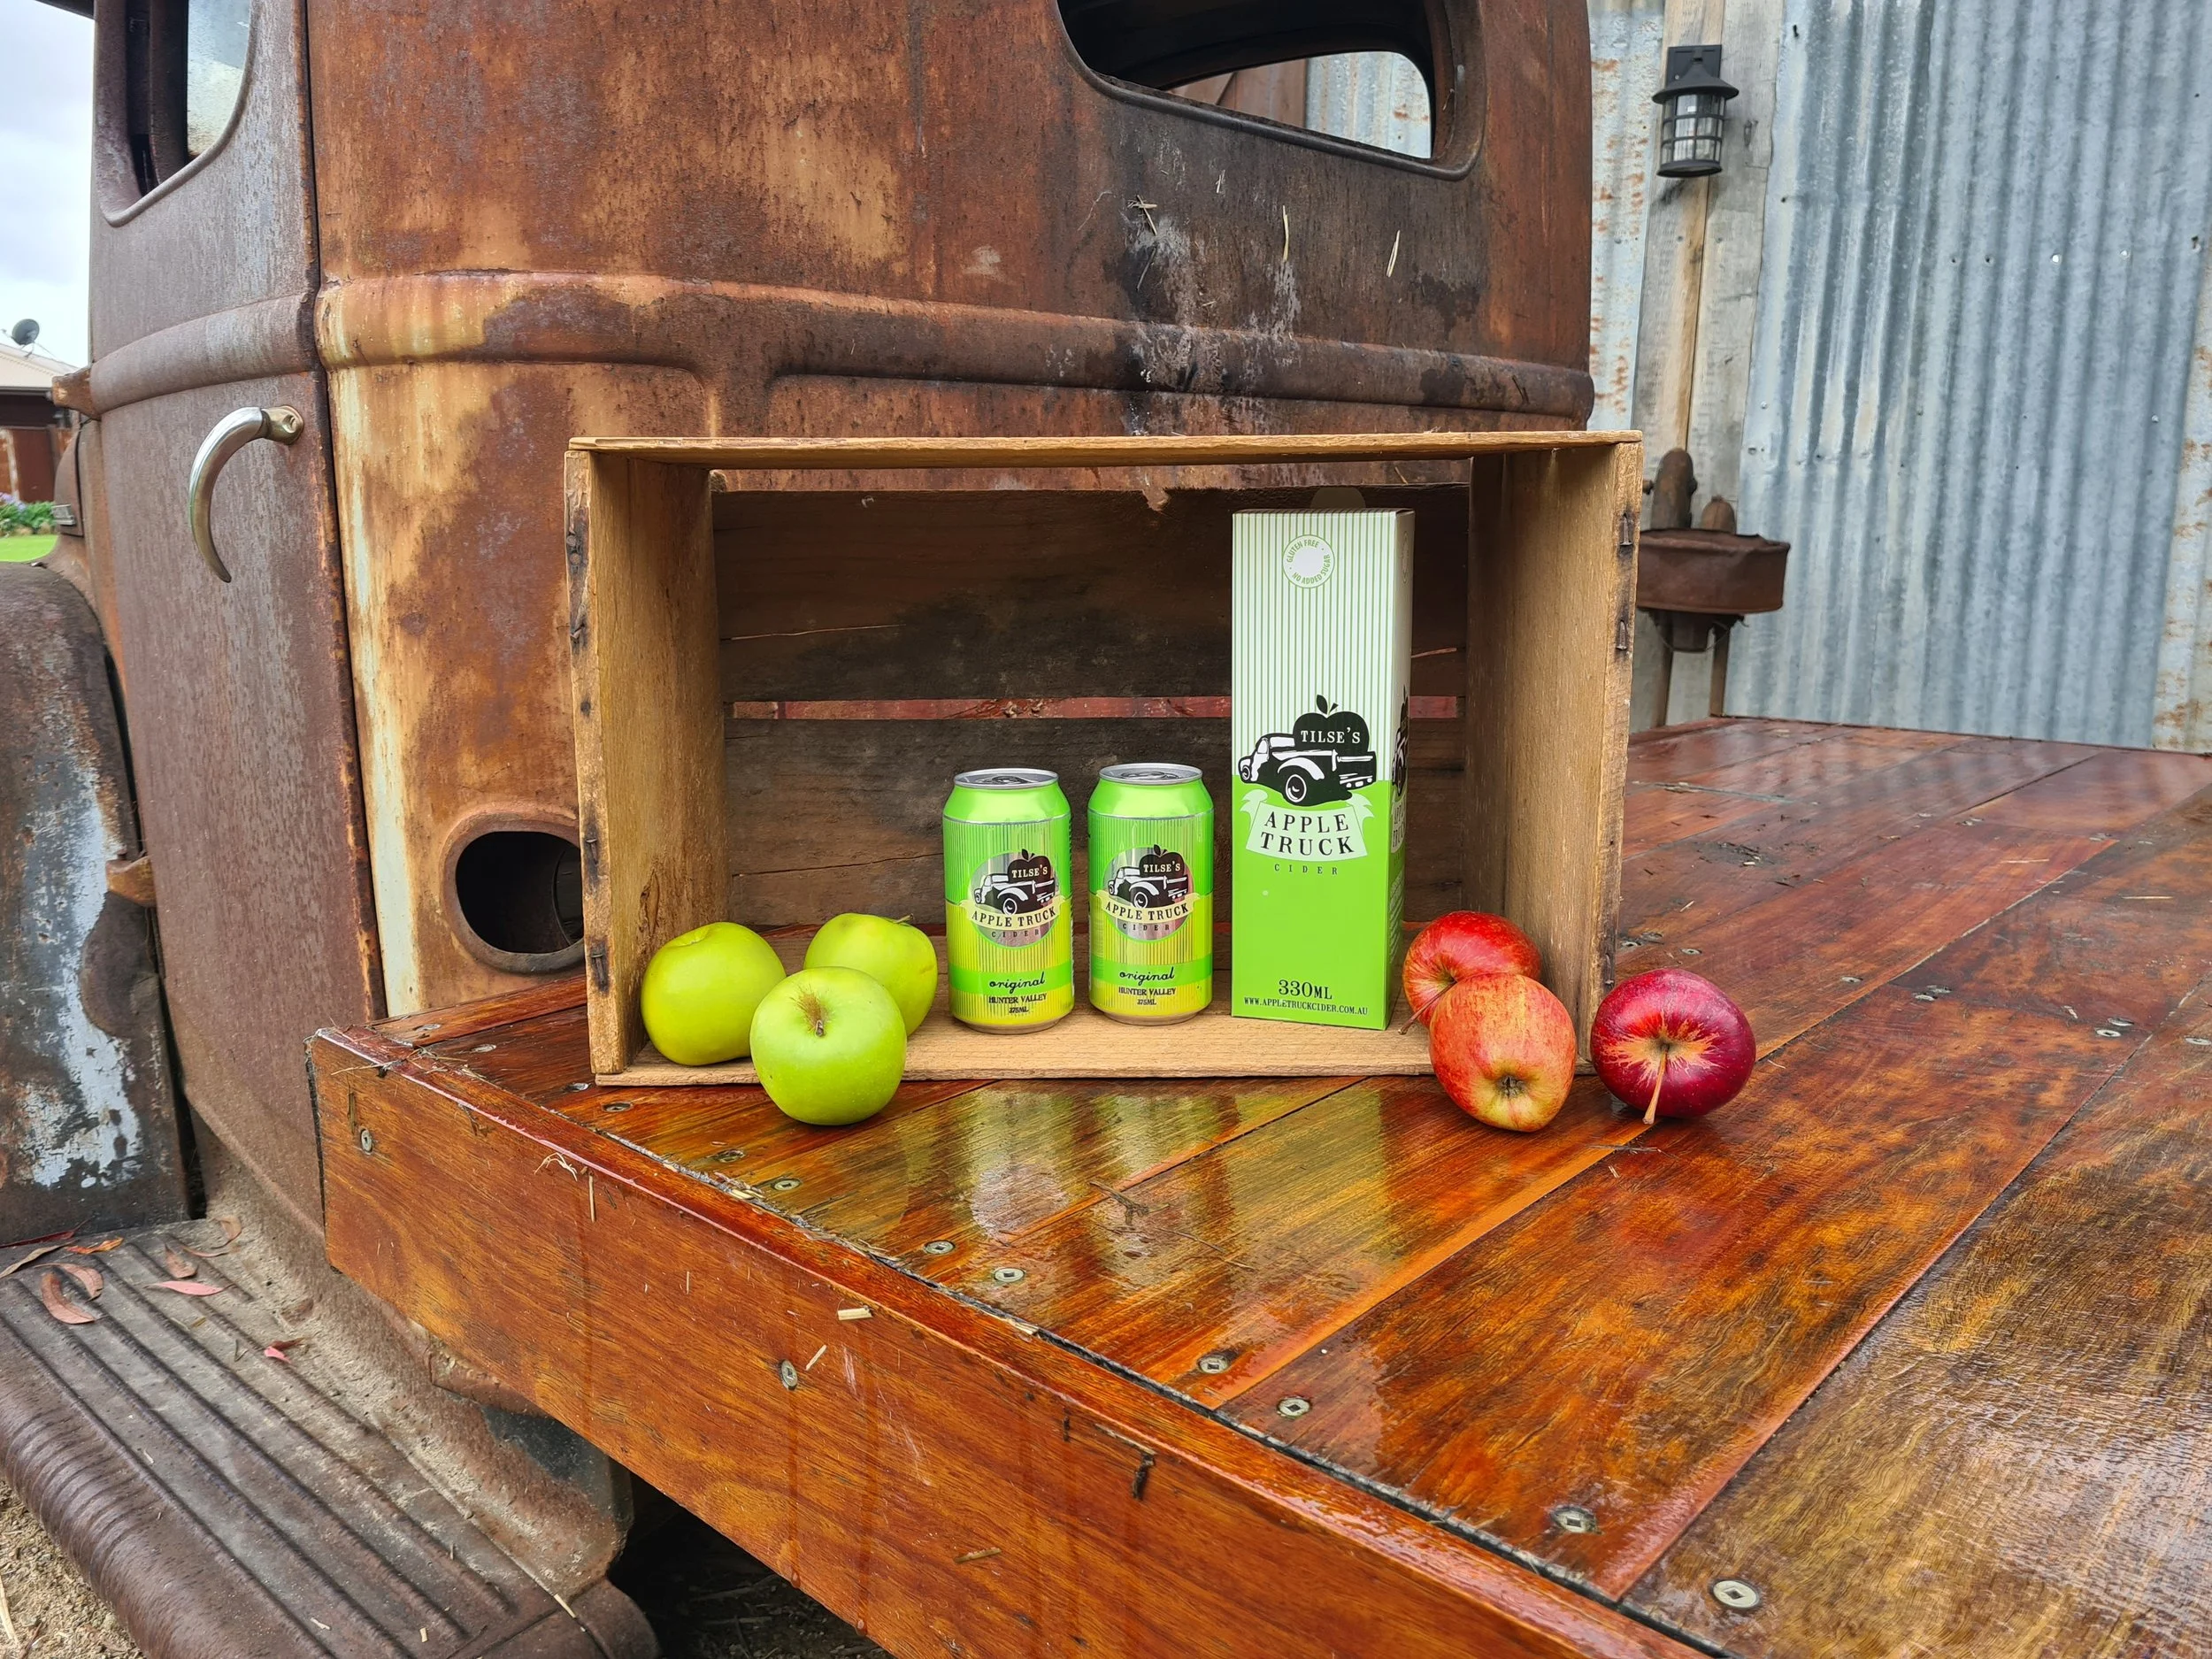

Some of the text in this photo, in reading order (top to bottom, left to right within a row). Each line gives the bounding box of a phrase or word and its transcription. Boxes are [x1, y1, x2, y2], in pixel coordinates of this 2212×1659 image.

[1286, 539, 1320, 563] GLUTEN FREE
[1292, 554, 1332, 585] NO ADDED SUGAR
[1300, 726, 1361, 744] TILSE'S
[1263, 810, 1349, 833] APPLE
[1260, 831, 1355, 856] TRUCK
[1011, 864, 1048, 879] TILSE'S
[1142, 860, 1181, 872] TILSE'S
[1274, 863, 1339, 875] CIDER
[972, 906, 1056, 927] APPLE TRUCK
[1105, 901, 1188, 921] APPLE TRUCK
[991, 929, 1040, 938] CIDER
[1122, 923, 1170, 932] CIDER
[988, 971, 1046, 995] original
[1118, 965, 1175, 987] original
[988, 993, 1048, 1004] HUNTER VALLEY
[1118, 987, 1177, 996] HUNTER VALLEY
[1279, 979, 1333, 1000] 330ML
[1243, 996, 1369, 1016] WWW.APPLETRUCKCIDER.COM.AU
